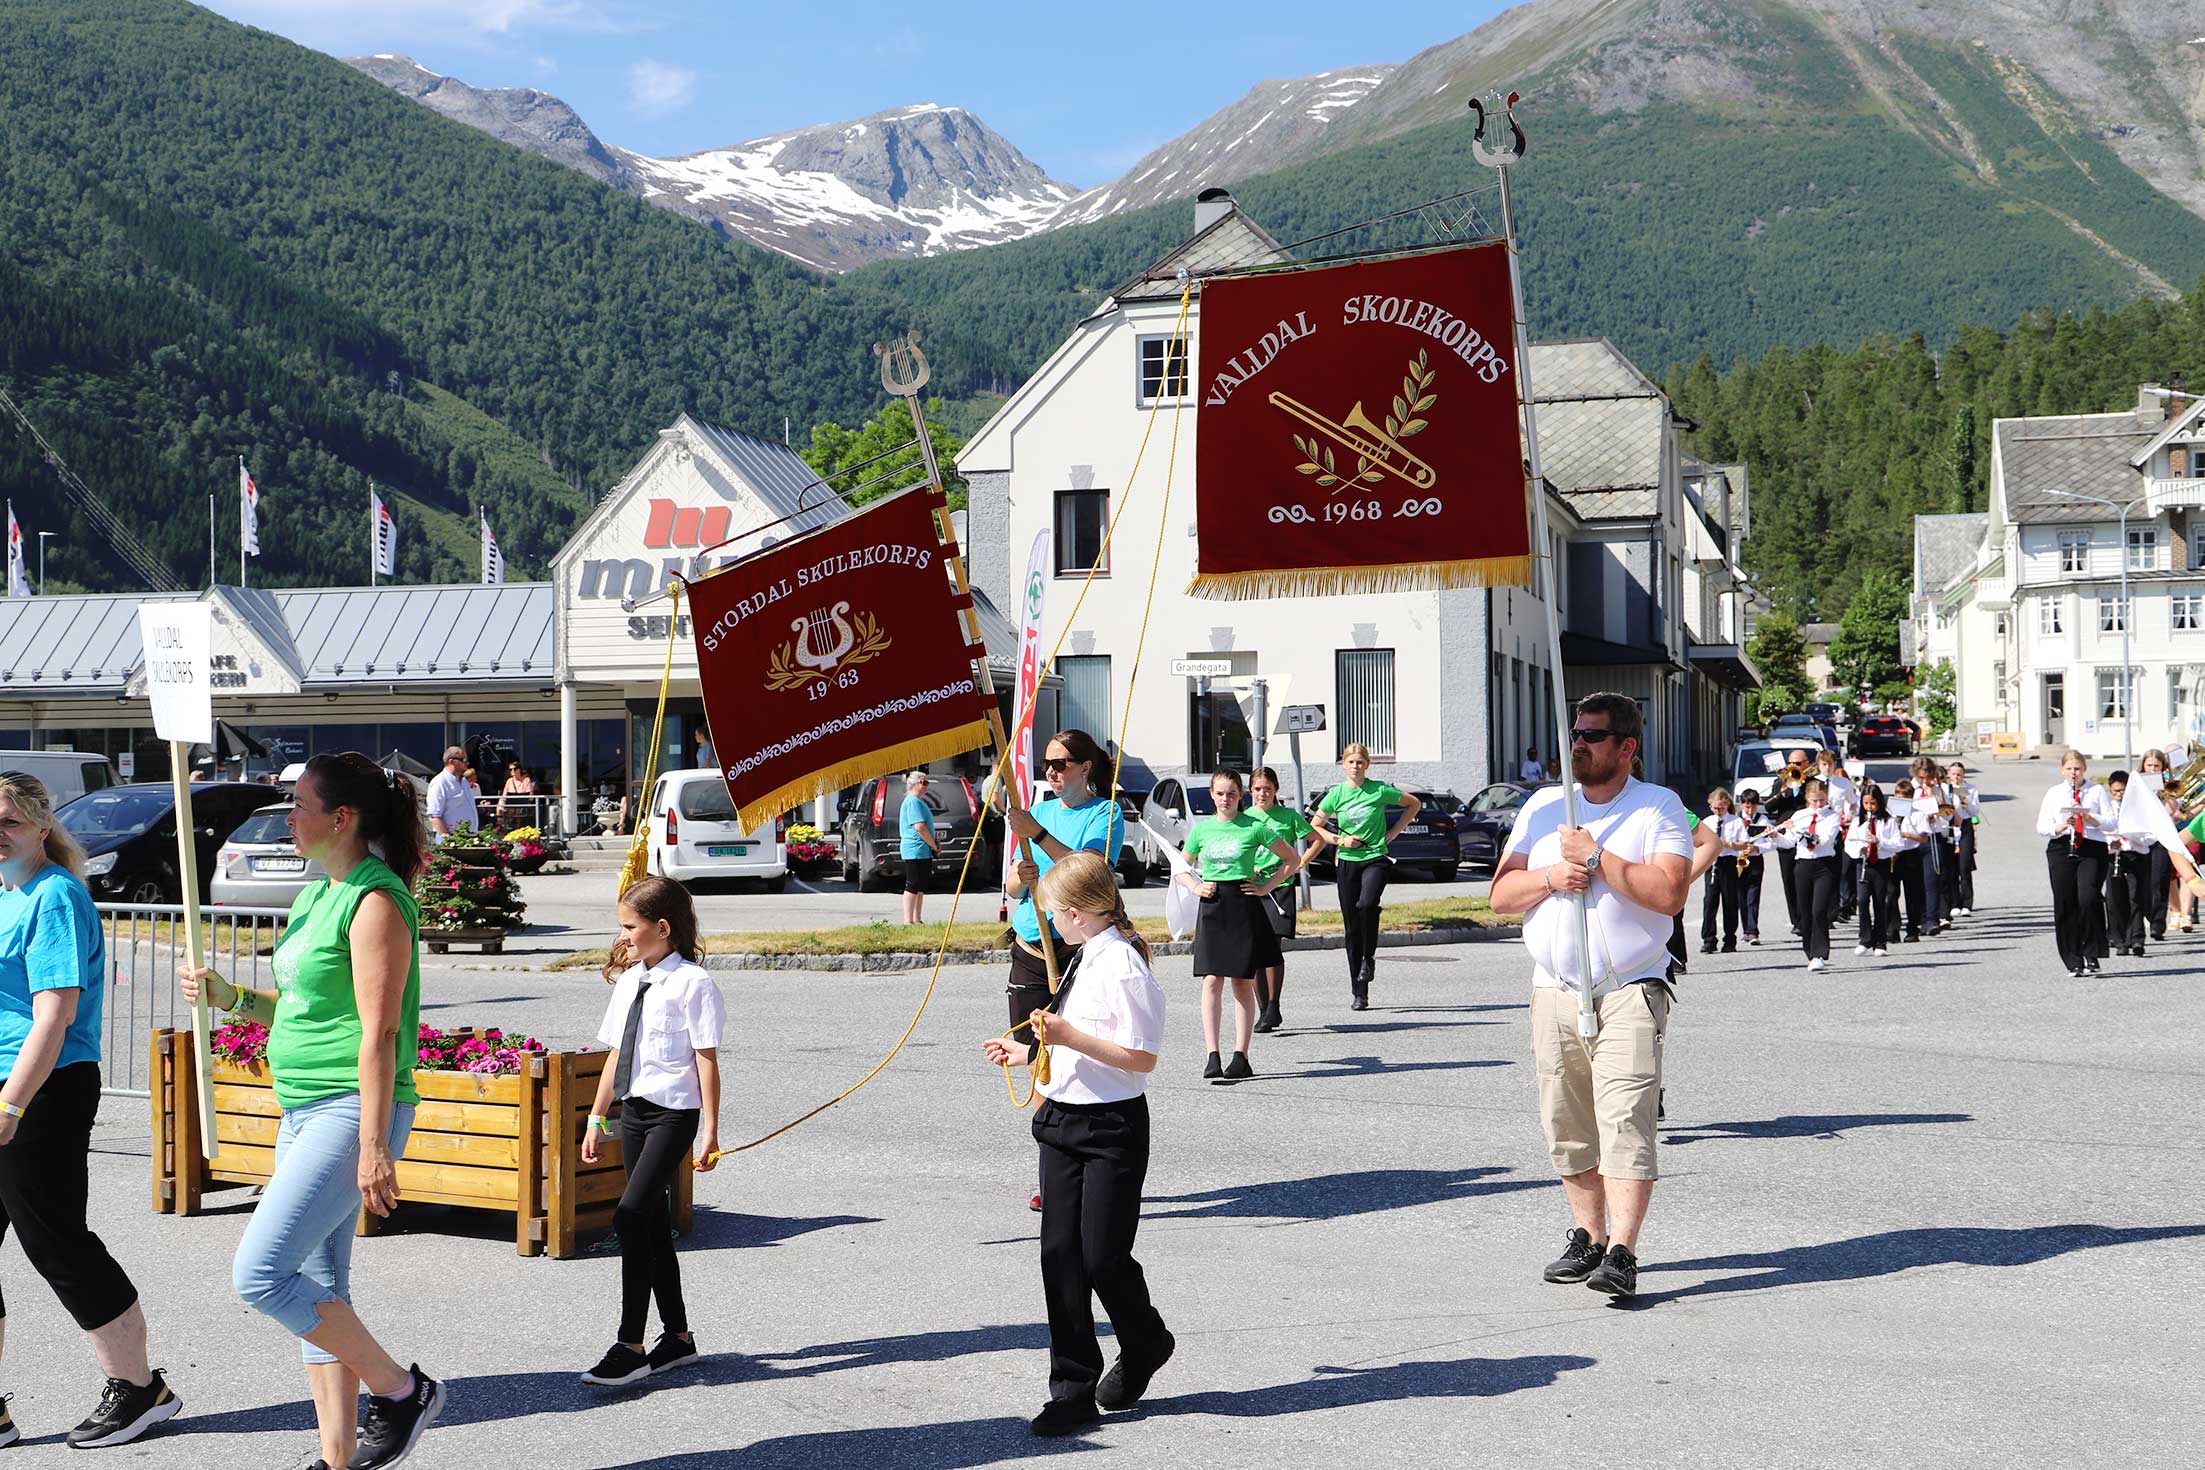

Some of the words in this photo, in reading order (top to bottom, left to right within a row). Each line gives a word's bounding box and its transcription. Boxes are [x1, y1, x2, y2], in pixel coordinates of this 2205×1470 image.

[1205, 310, 1317, 408] VALLDAL
[1343, 294, 1510, 384] SKOLEKORPS
[1322, 499, 1383, 525] 1968
[703, 578, 793, 652] STORDAL
[796, 544, 932, 589] SKULEKORPS
[1175, 662, 1228, 674] Grandegata
[418, 1381, 430, 1406] HOKA
